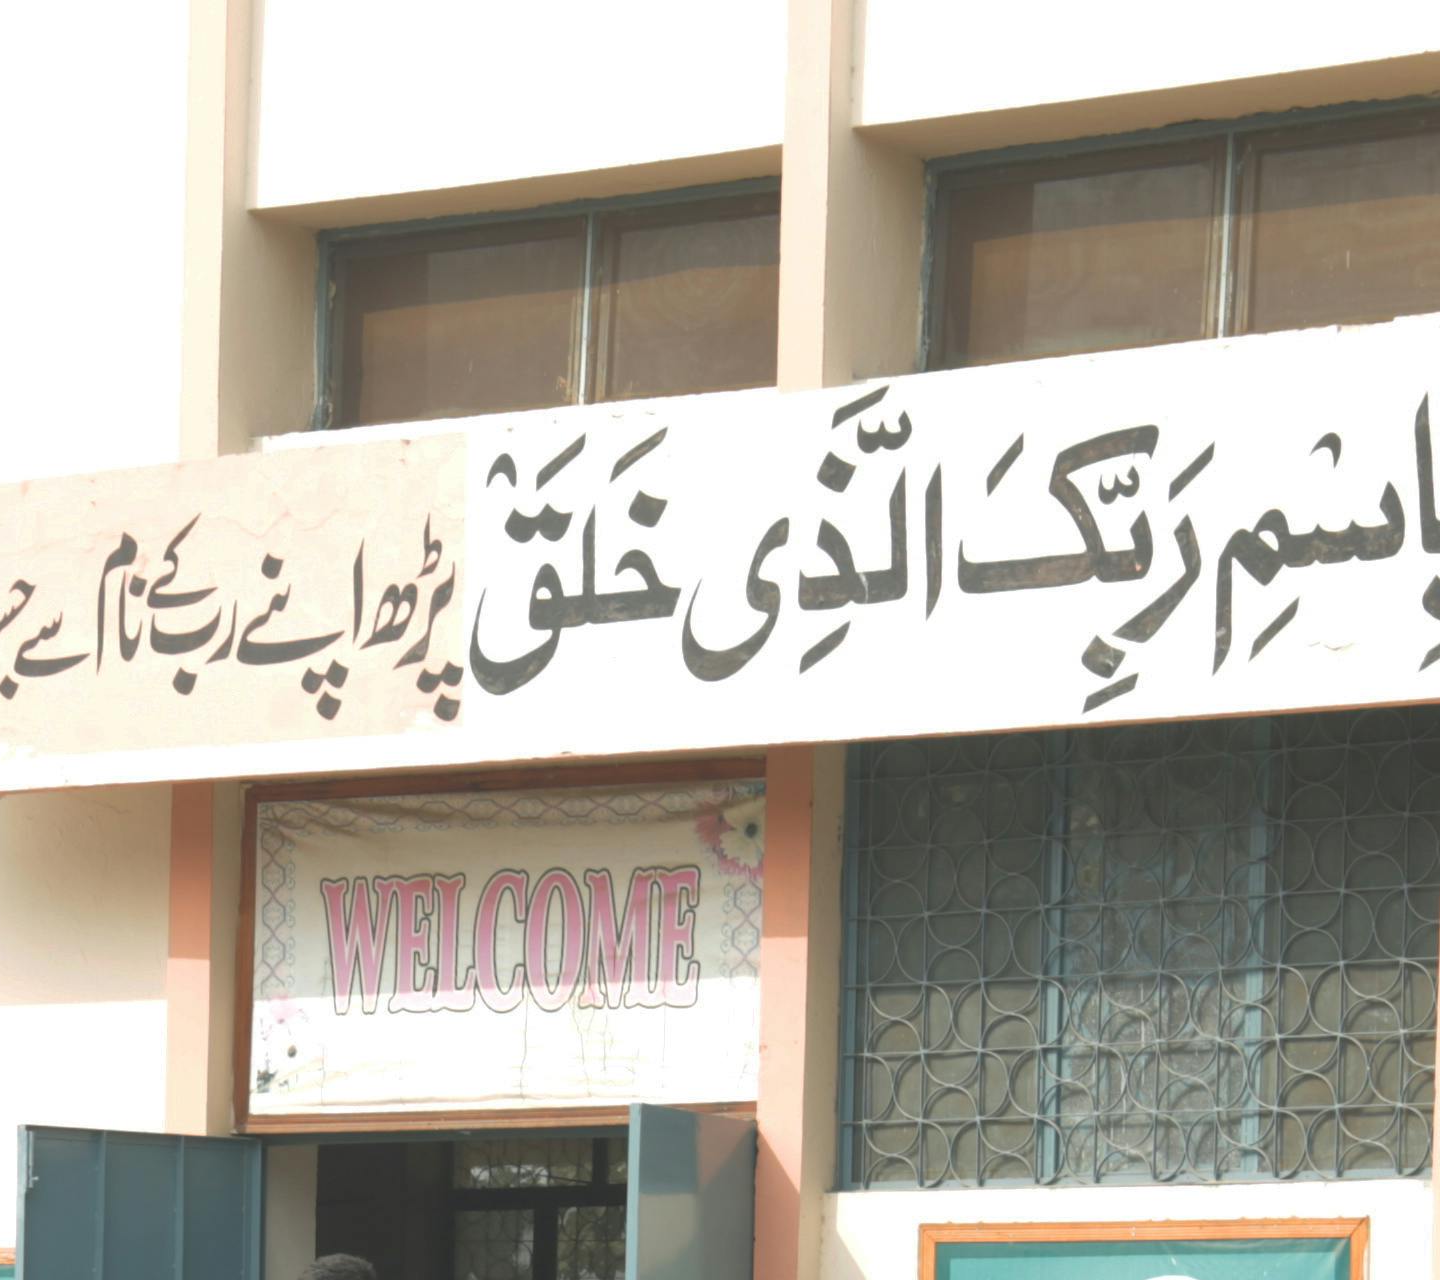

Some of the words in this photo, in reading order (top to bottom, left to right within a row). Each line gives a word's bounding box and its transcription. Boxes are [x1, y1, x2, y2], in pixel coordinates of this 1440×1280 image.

[96, 530, 147, 675] نام
[147, 512, 218, 609] کے
[236, 539, 364, 720] اپنے
[361, 513, 464, 722] پڑھ
[14, 608, 90, 677] سے
[149, 592, 238, 696] رب
[321, 866, 702, 1016] WELCOME
